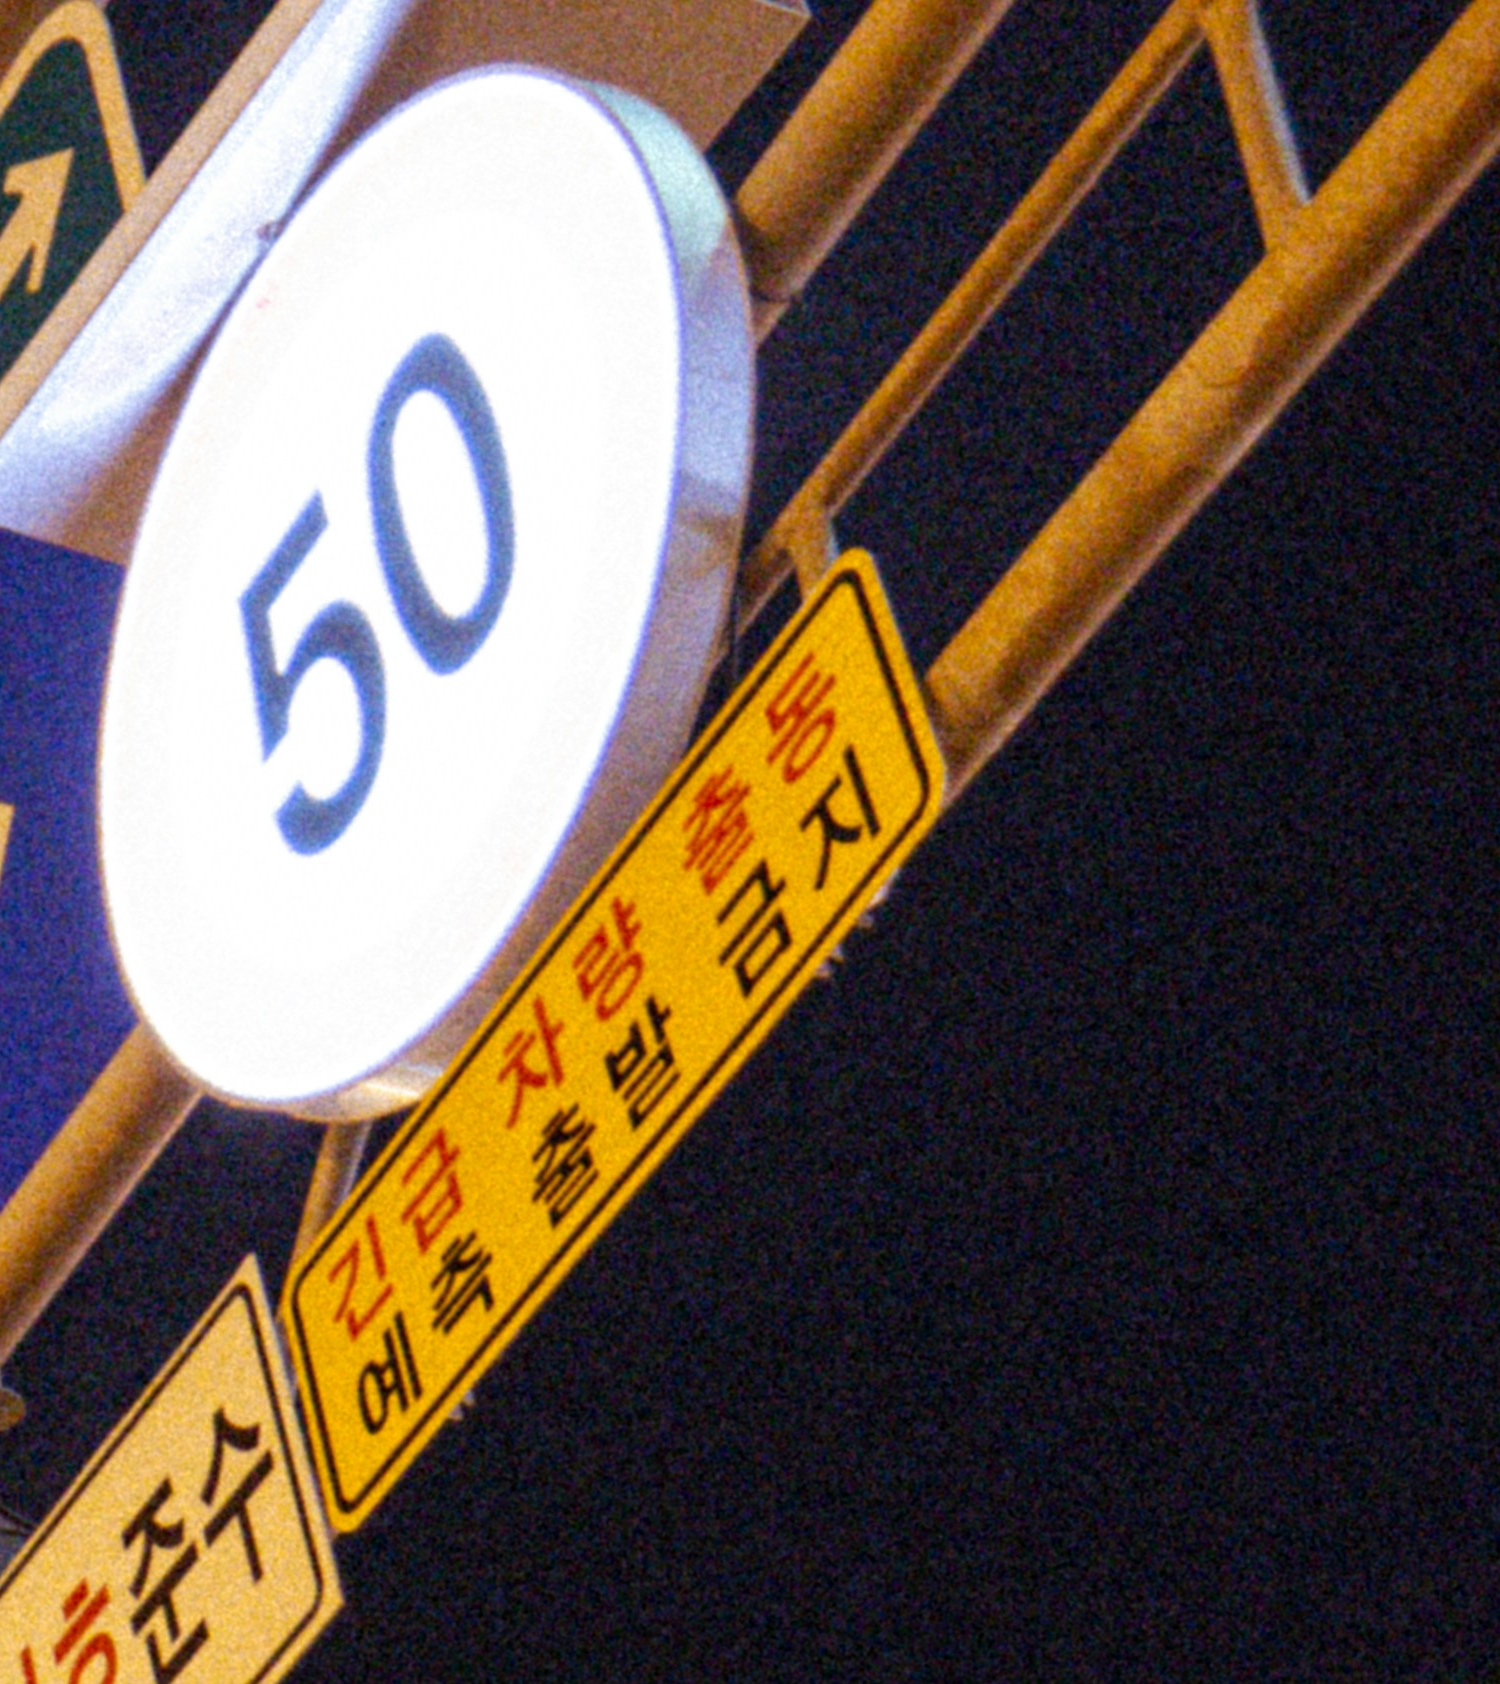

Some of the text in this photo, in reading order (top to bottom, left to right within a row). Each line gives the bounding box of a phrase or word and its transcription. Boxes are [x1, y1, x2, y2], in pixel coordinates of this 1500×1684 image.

[237, 332, 517, 857] 50
[325, 651, 838, 1342] 긴급 차량 출동
[355, 743, 882, 1436] 예측 출발 금지
